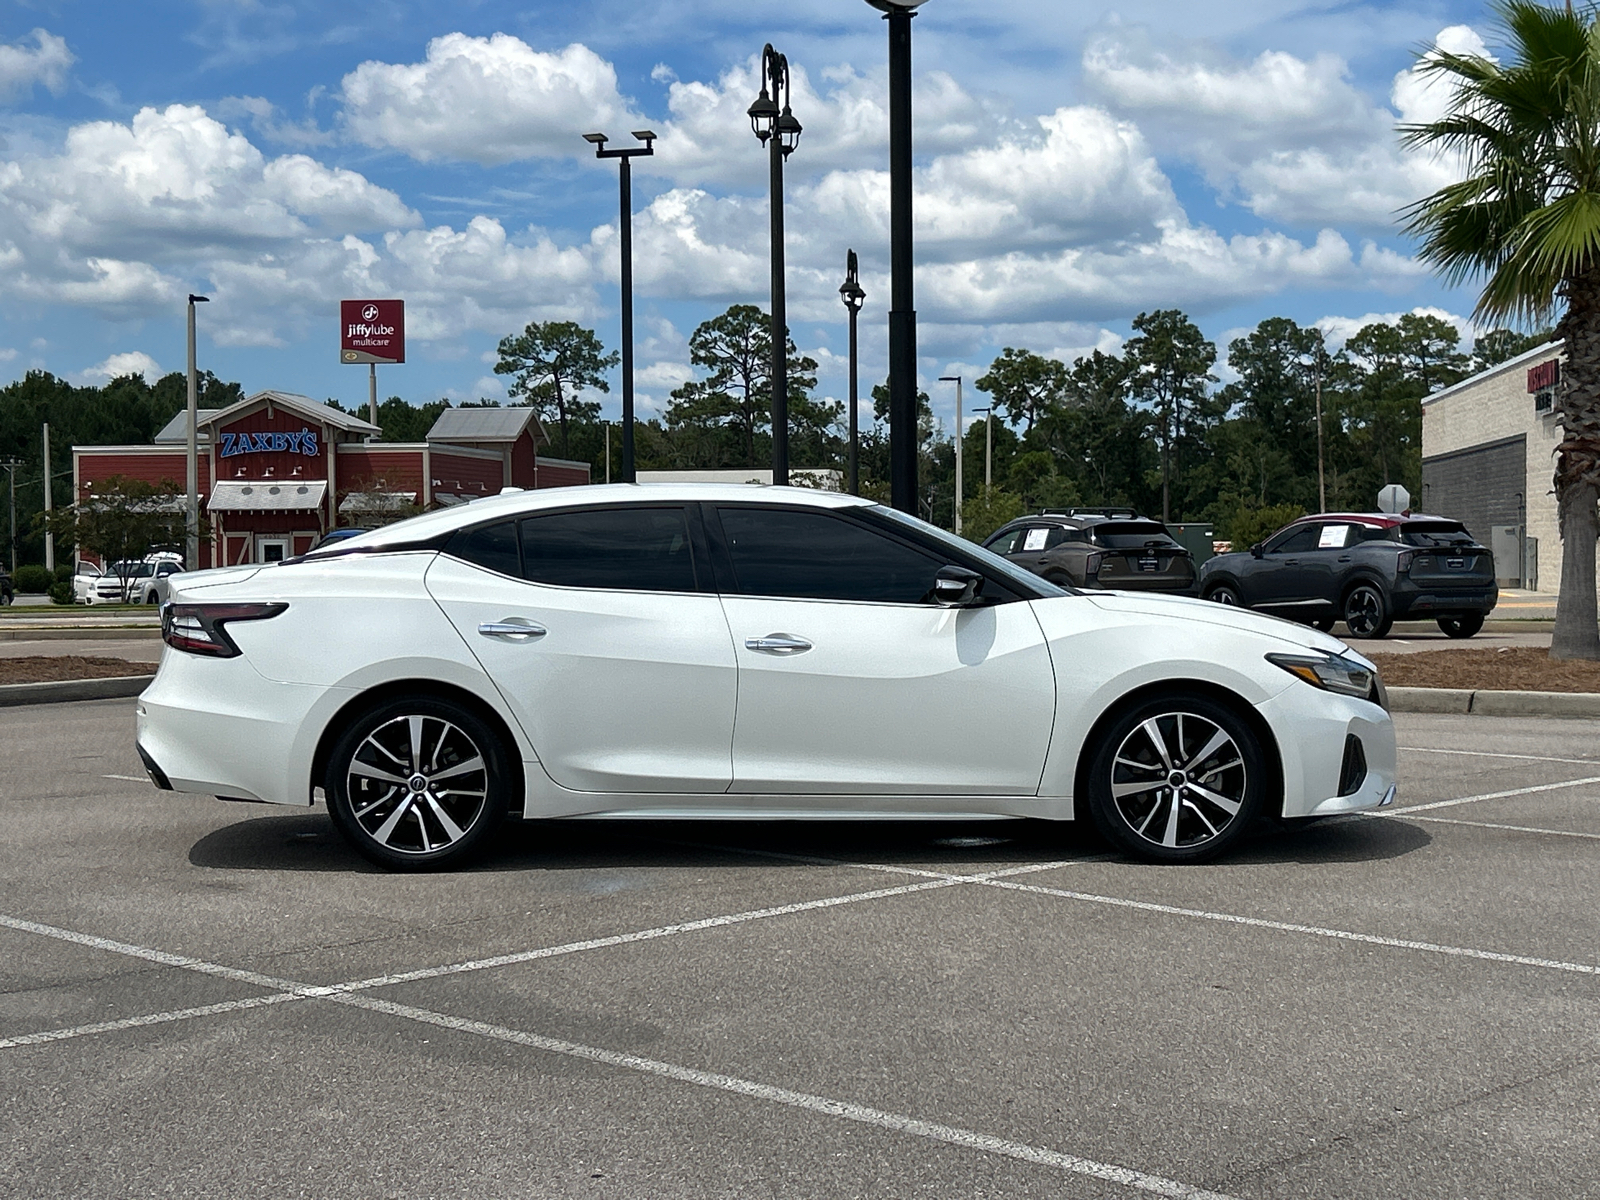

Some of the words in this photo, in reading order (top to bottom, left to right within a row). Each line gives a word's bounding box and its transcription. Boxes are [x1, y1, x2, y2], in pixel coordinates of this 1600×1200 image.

[347, 324, 394, 338] jiffylube
[353, 338, 390, 346] multicare
[220, 427, 318, 458] ZAXBY'S
